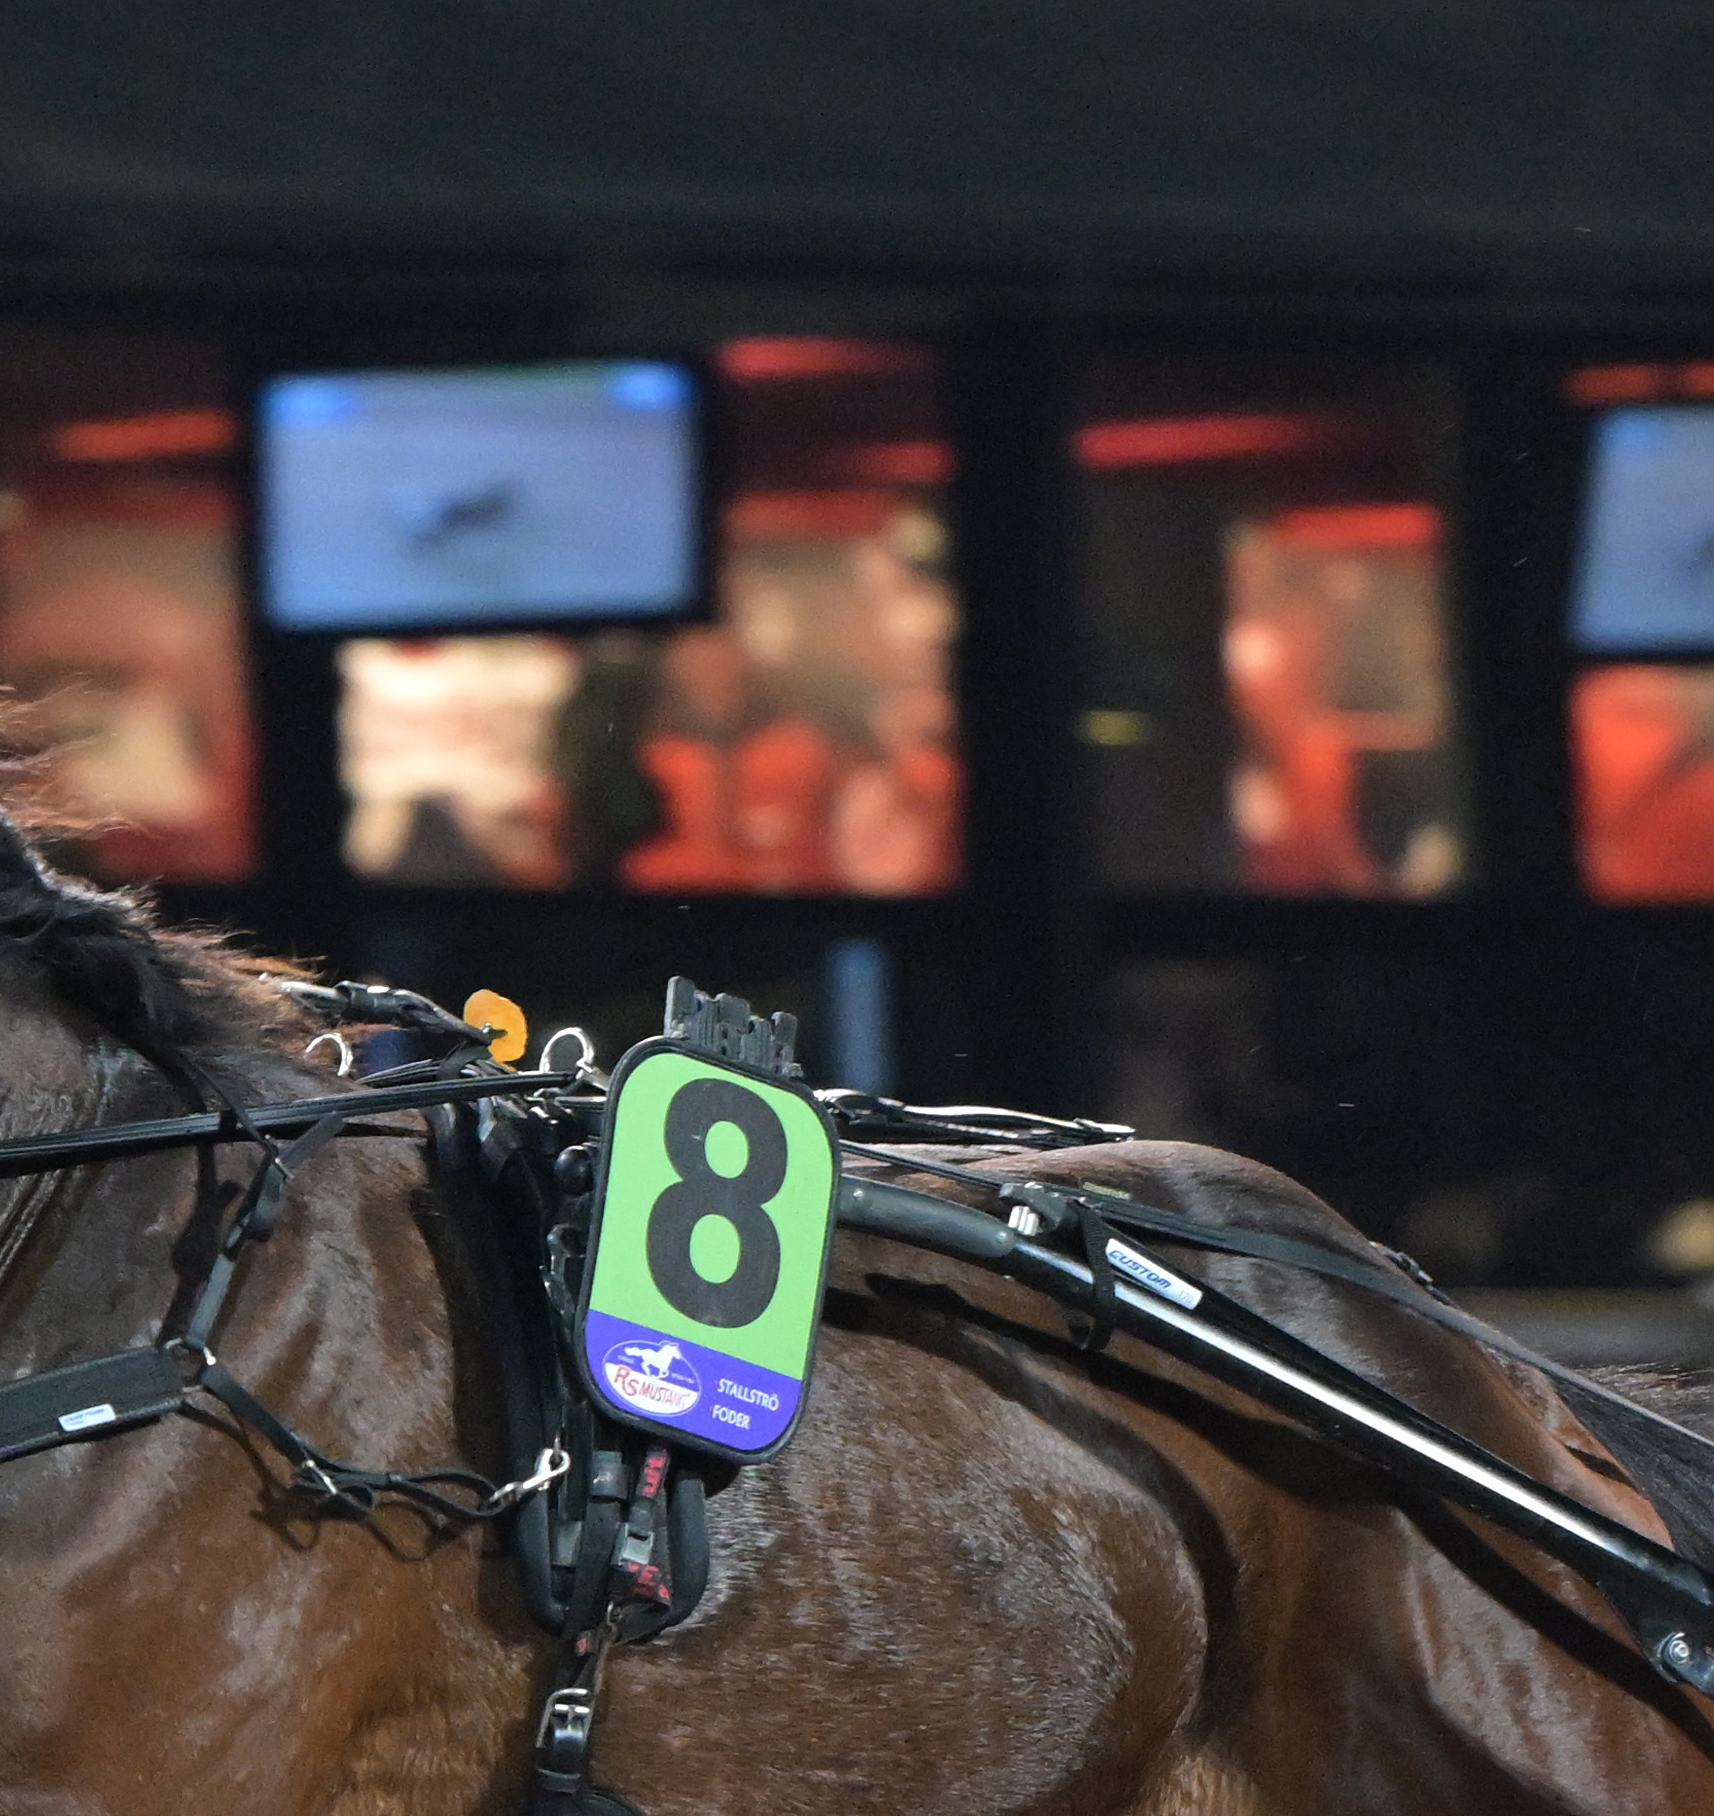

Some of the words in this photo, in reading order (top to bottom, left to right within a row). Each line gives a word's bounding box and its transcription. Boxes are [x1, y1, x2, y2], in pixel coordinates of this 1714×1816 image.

[646, 1077, 788, 1329] 8
[1109, 1250, 1172, 1289] CUSTOM
[638, 1380, 691, 1410] MUSTANG
[717, 1378, 779, 1411] STALLSTRÖ
[712, 1404, 750, 1430] FODER
